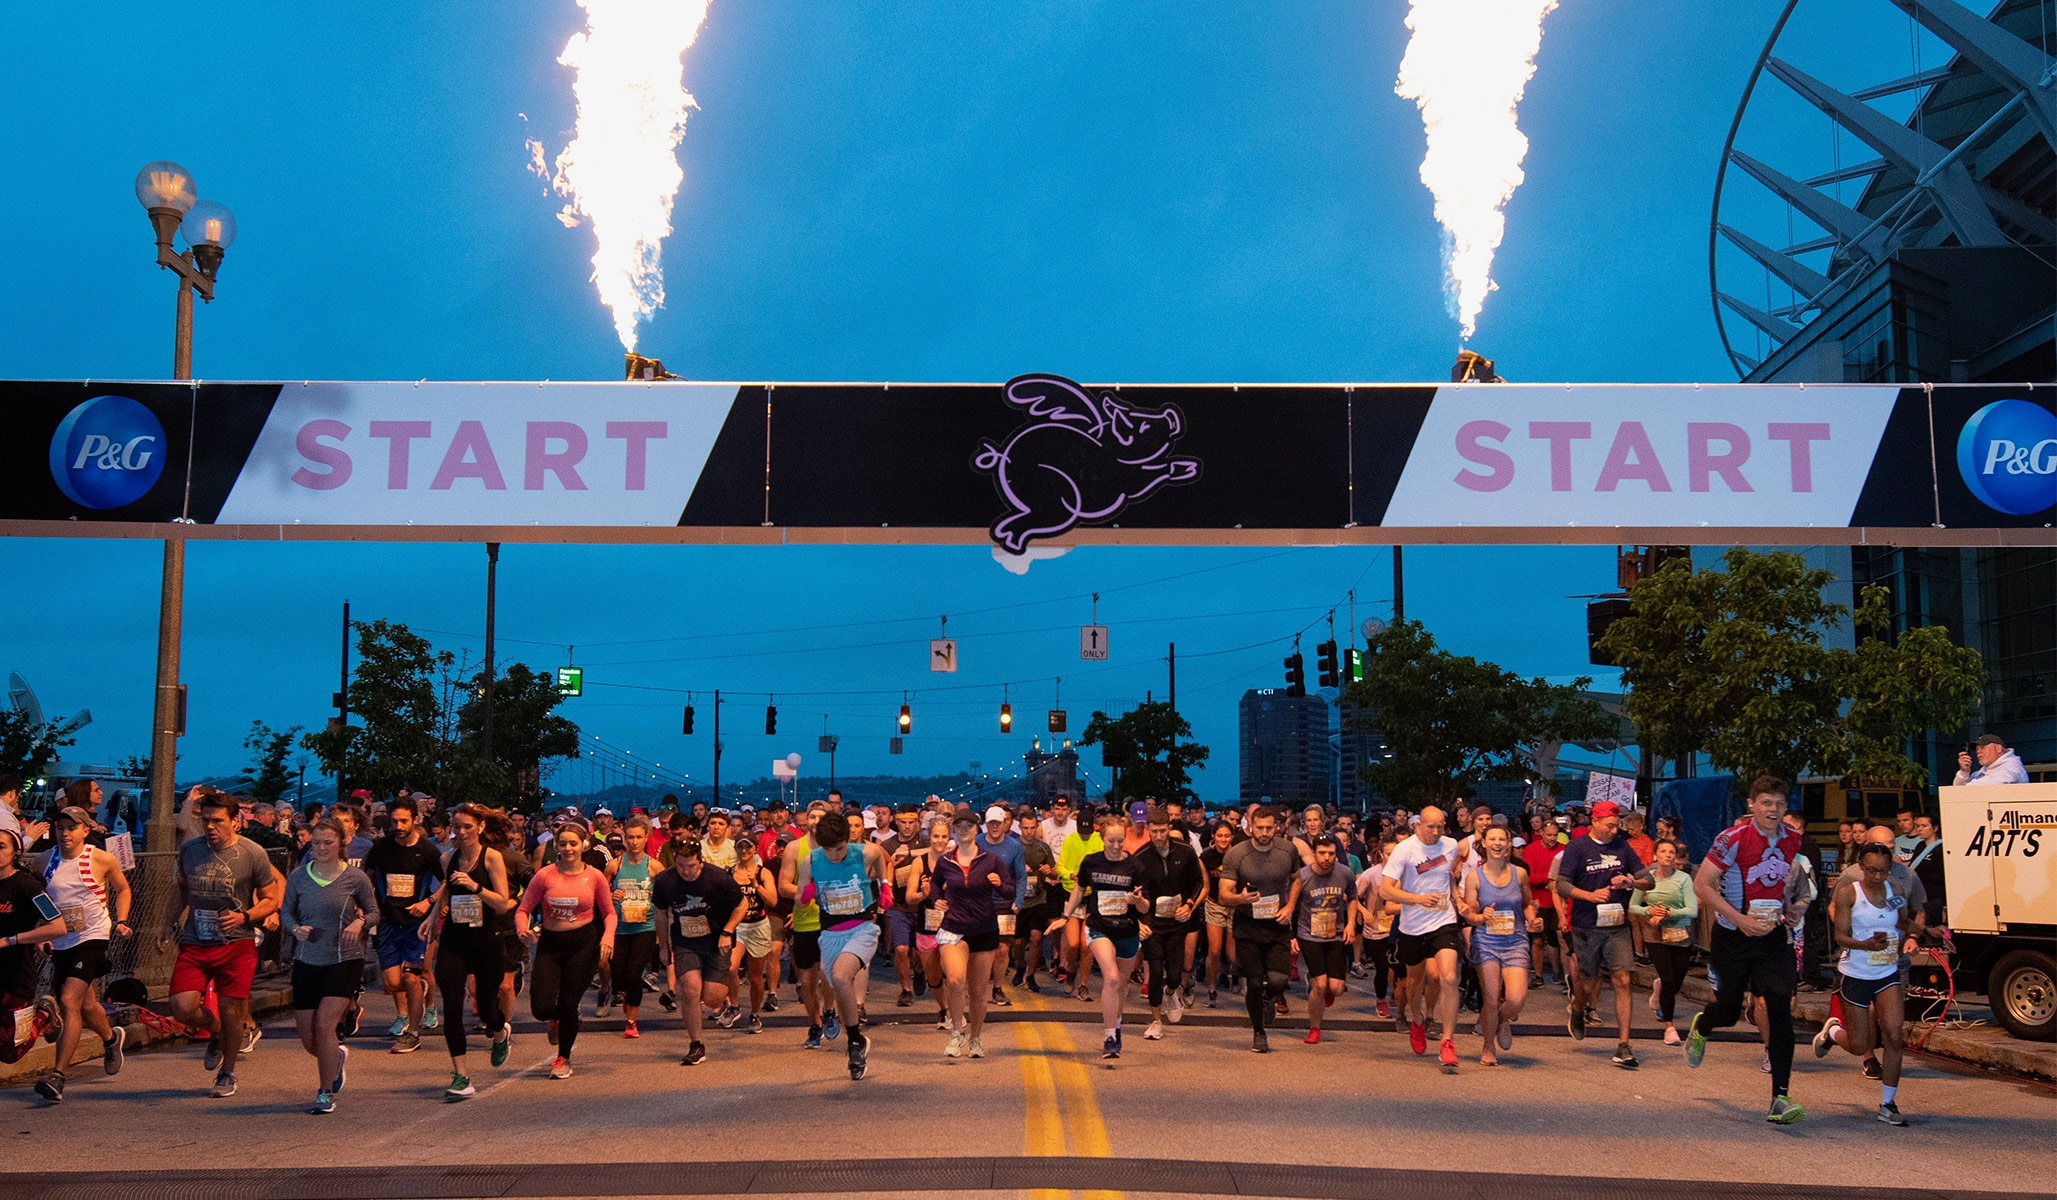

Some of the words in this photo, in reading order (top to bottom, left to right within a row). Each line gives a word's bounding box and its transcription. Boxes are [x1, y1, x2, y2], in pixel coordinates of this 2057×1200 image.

[73, 435, 156, 470] P&G
[291, 419, 668, 491] START
[1453, 419, 1831, 493] START
[1983, 439, 2057, 475] P&G
[1083, 650, 1105, 658] ONLY
[1965, 825, 2042, 857] ART'S
